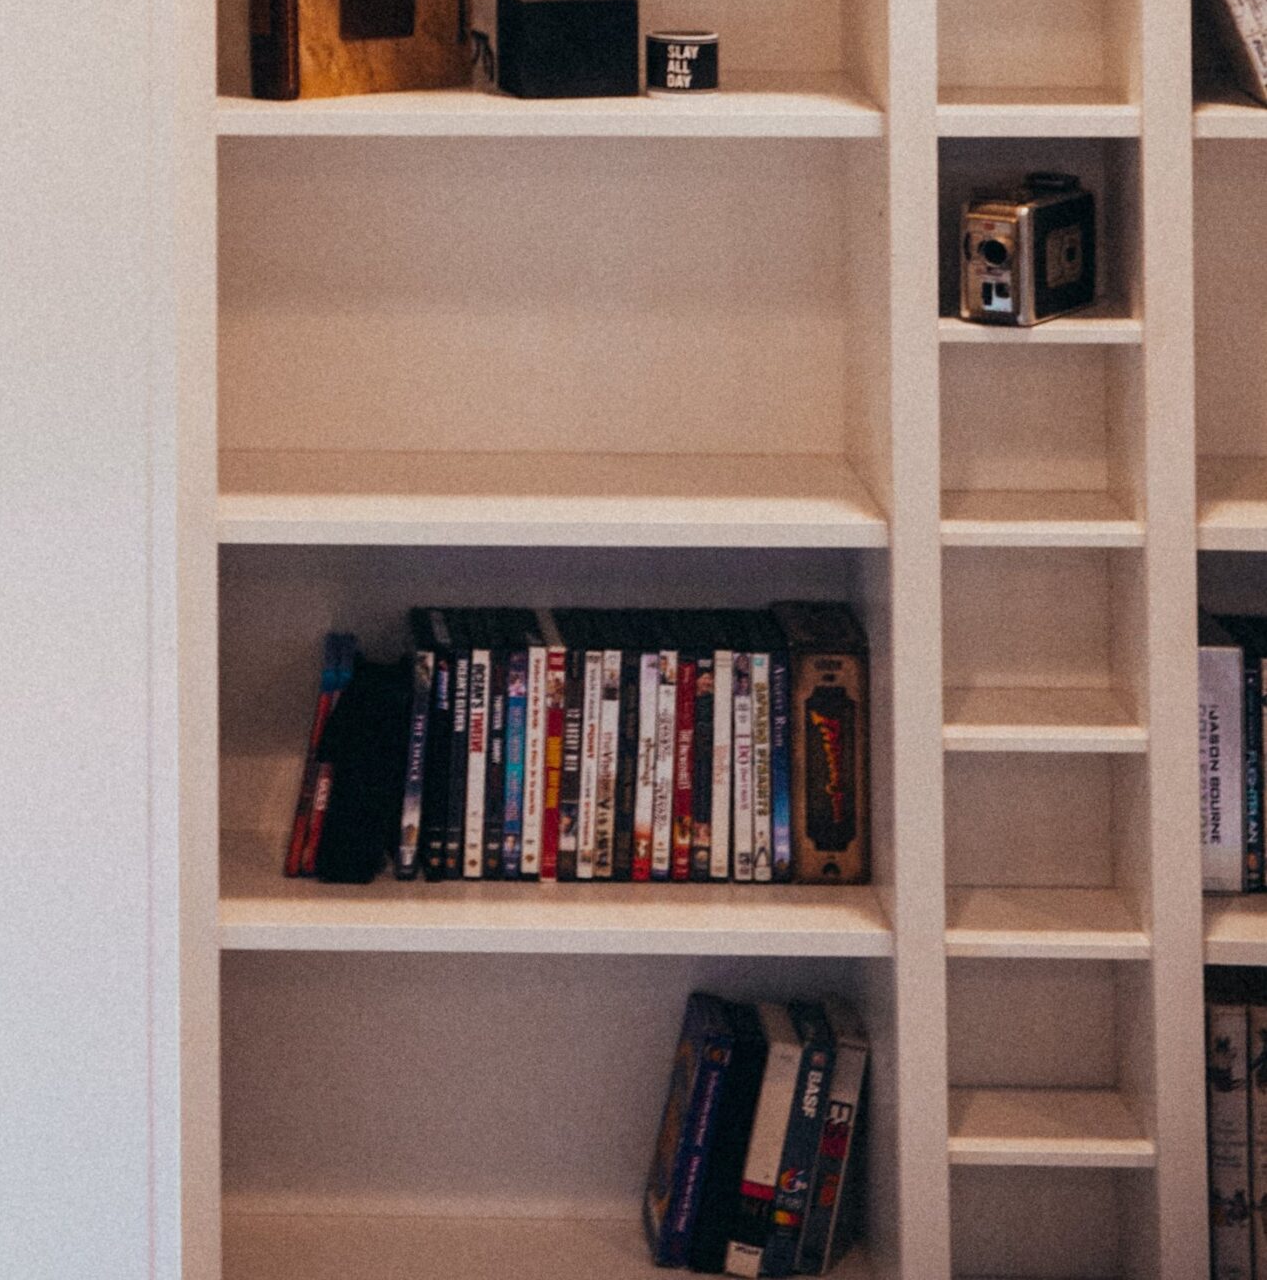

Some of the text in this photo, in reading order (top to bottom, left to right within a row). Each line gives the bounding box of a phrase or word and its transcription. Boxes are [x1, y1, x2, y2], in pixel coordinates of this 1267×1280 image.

[667, 44, 699, 60] SLAY
[667, 60, 691, 74] ALL
[666, 73, 692, 89] DAY
[469, 663, 486, 753] OCEAN'S TWELVE
[1208, 709, 1222, 844] JASON BOURNE
[801, 1070, 824, 1118] BASF
